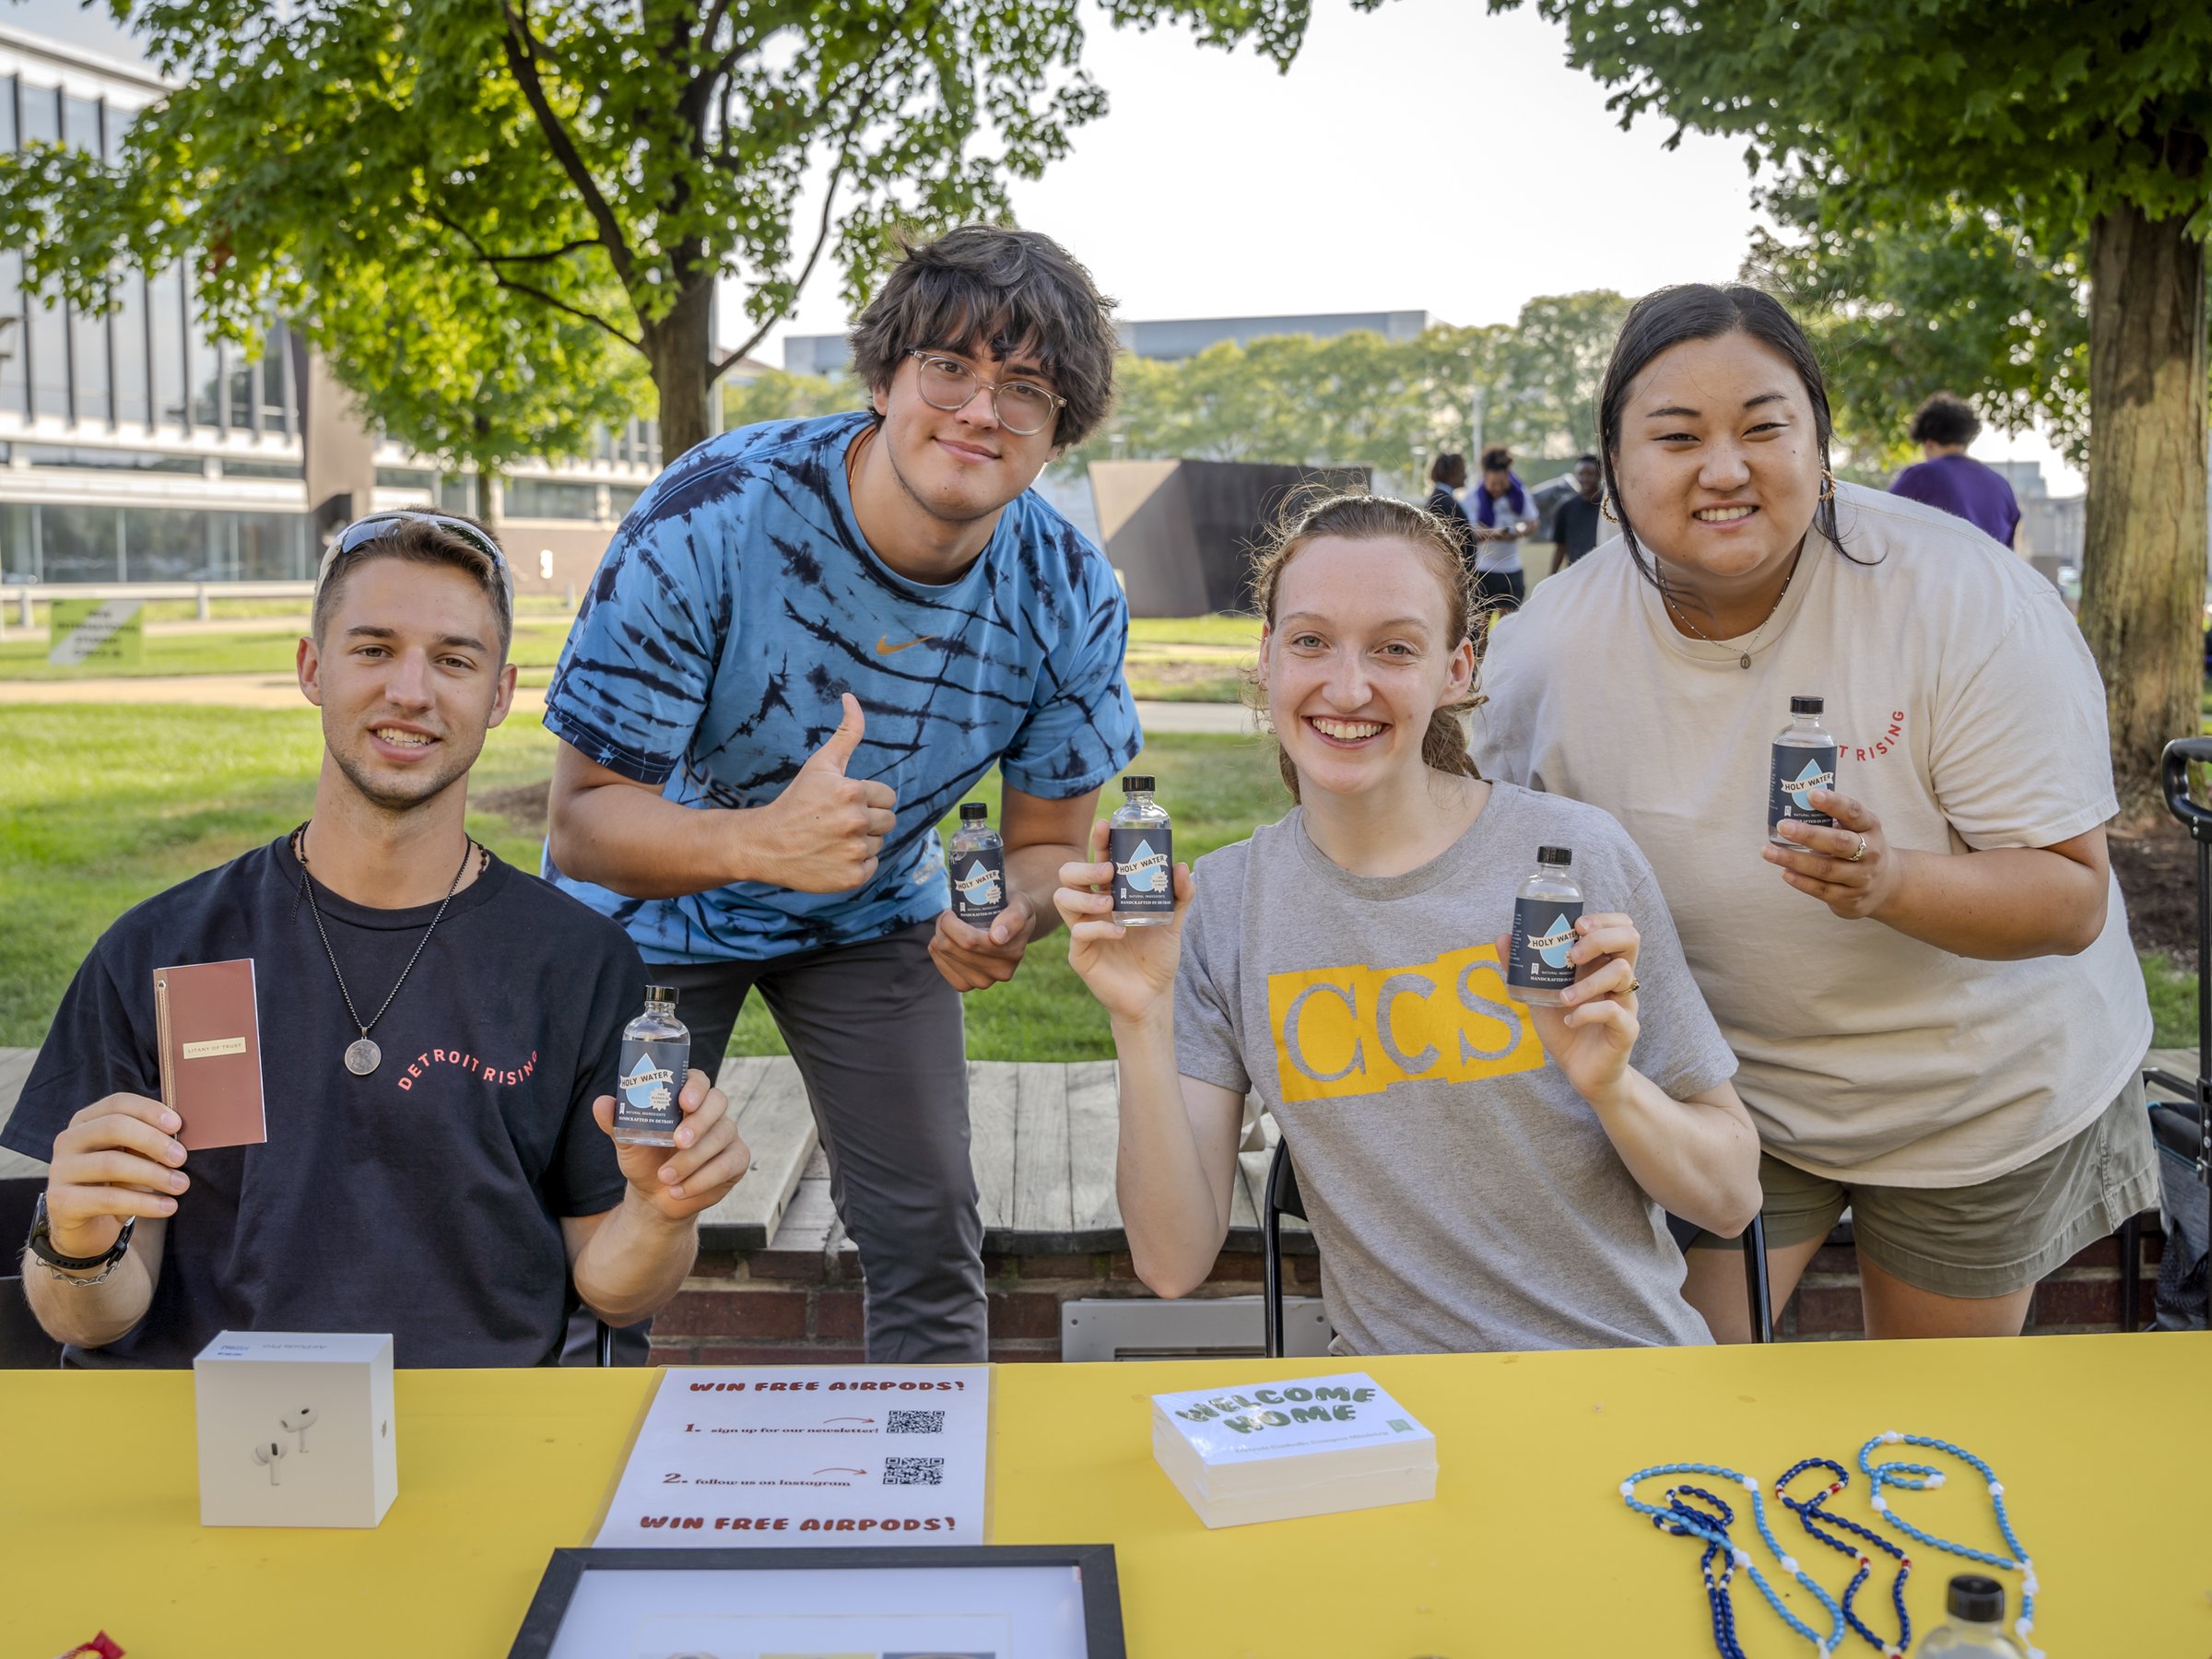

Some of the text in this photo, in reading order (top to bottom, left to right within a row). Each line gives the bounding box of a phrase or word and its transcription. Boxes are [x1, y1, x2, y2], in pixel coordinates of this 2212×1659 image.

[1856, 711, 1904, 761] RISING
[1785, 774, 1831, 791] HOLY WATER
[1120, 855, 1164, 873] HOLY WATER
[958, 872, 997, 889] HOLY WATER
[1532, 938, 1554, 947] HOLY
[1282, 959, 1523, 1082] CCS
[397, 1049, 479, 1091] DETROIT
[621, 1071, 669, 1087] HOLY WATER
[689, 1382, 965, 1391] WIN FREE AIRPODS!
[1175, 1387, 1376, 1422] WELCOME
[1224, 1405, 1356, 1433] HOME
[663, 1473, 688, 1484] 2.
[640, 1516, 956, 1531] WIN FREE AIRPODS!
